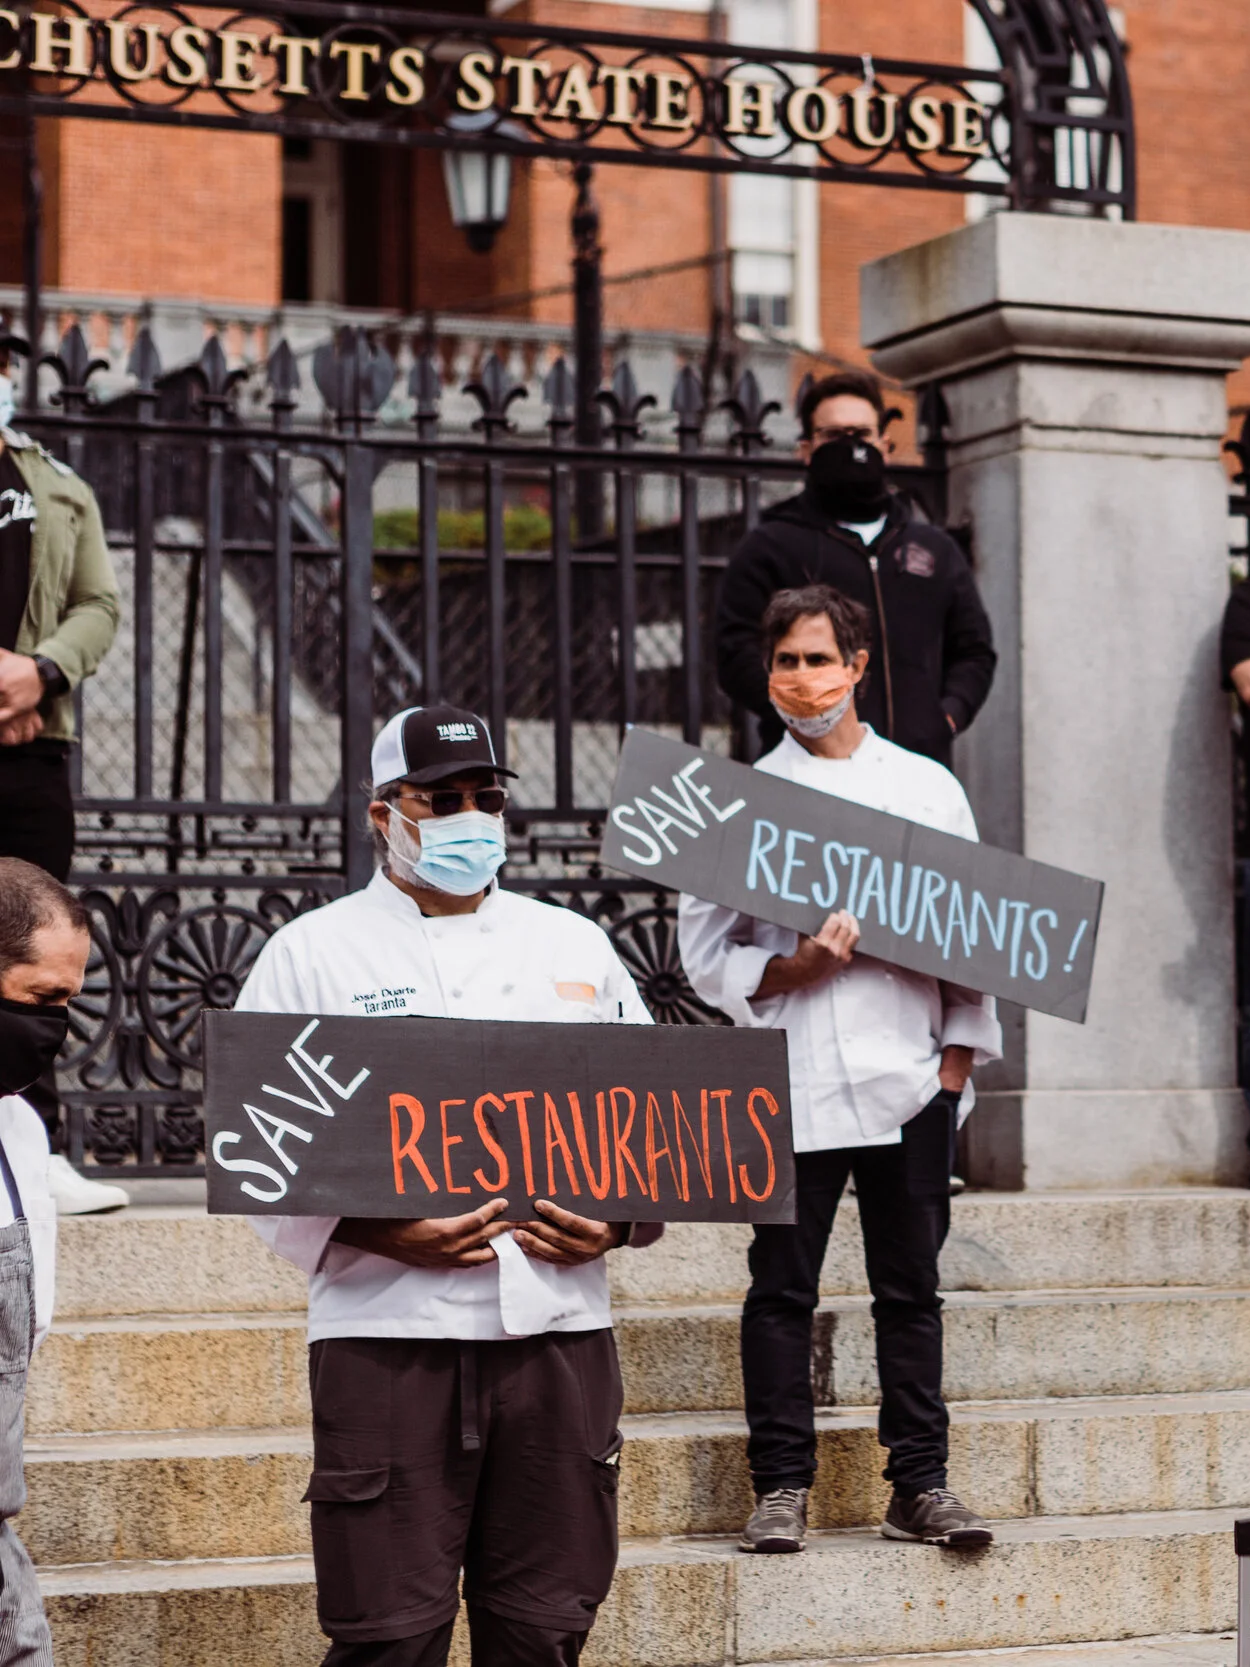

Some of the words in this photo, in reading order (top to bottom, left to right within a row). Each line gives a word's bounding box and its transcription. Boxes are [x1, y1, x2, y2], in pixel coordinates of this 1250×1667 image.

[455, 52, 694, 130] STATE
[725, 77, 988, 155] HOUSE
[612, 757, 747, 866] SAVE
[364, 997, 406, 1014] taranta
[381, 986, 417, 998] Duarte
[211, 1017, 372, 1203] SAVE
[388, 1086, 780, 1204] RESTAURANTS
